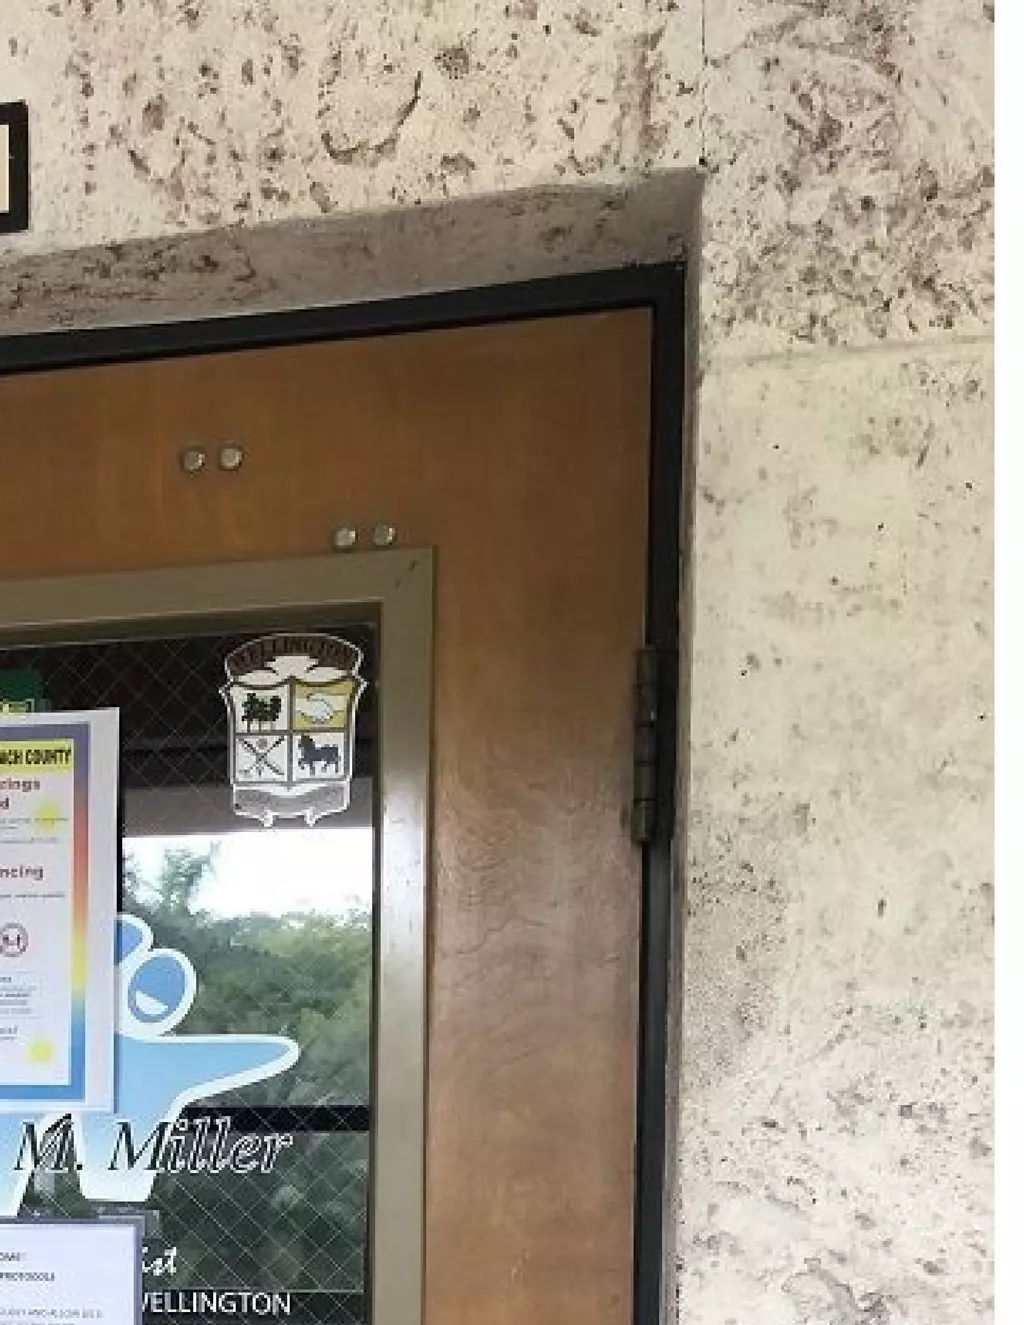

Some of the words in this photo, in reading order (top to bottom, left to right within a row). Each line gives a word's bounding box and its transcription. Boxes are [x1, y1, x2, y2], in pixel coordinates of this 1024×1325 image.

[25, 748, 72, 765] COUNTY
[13, 1119, 83, 1174] M.
[108, 1115, 294, 1174] Miller
[142, 1246, 177, 1276] ist
[142, 1291, 291, 1315] ELLINGTON
